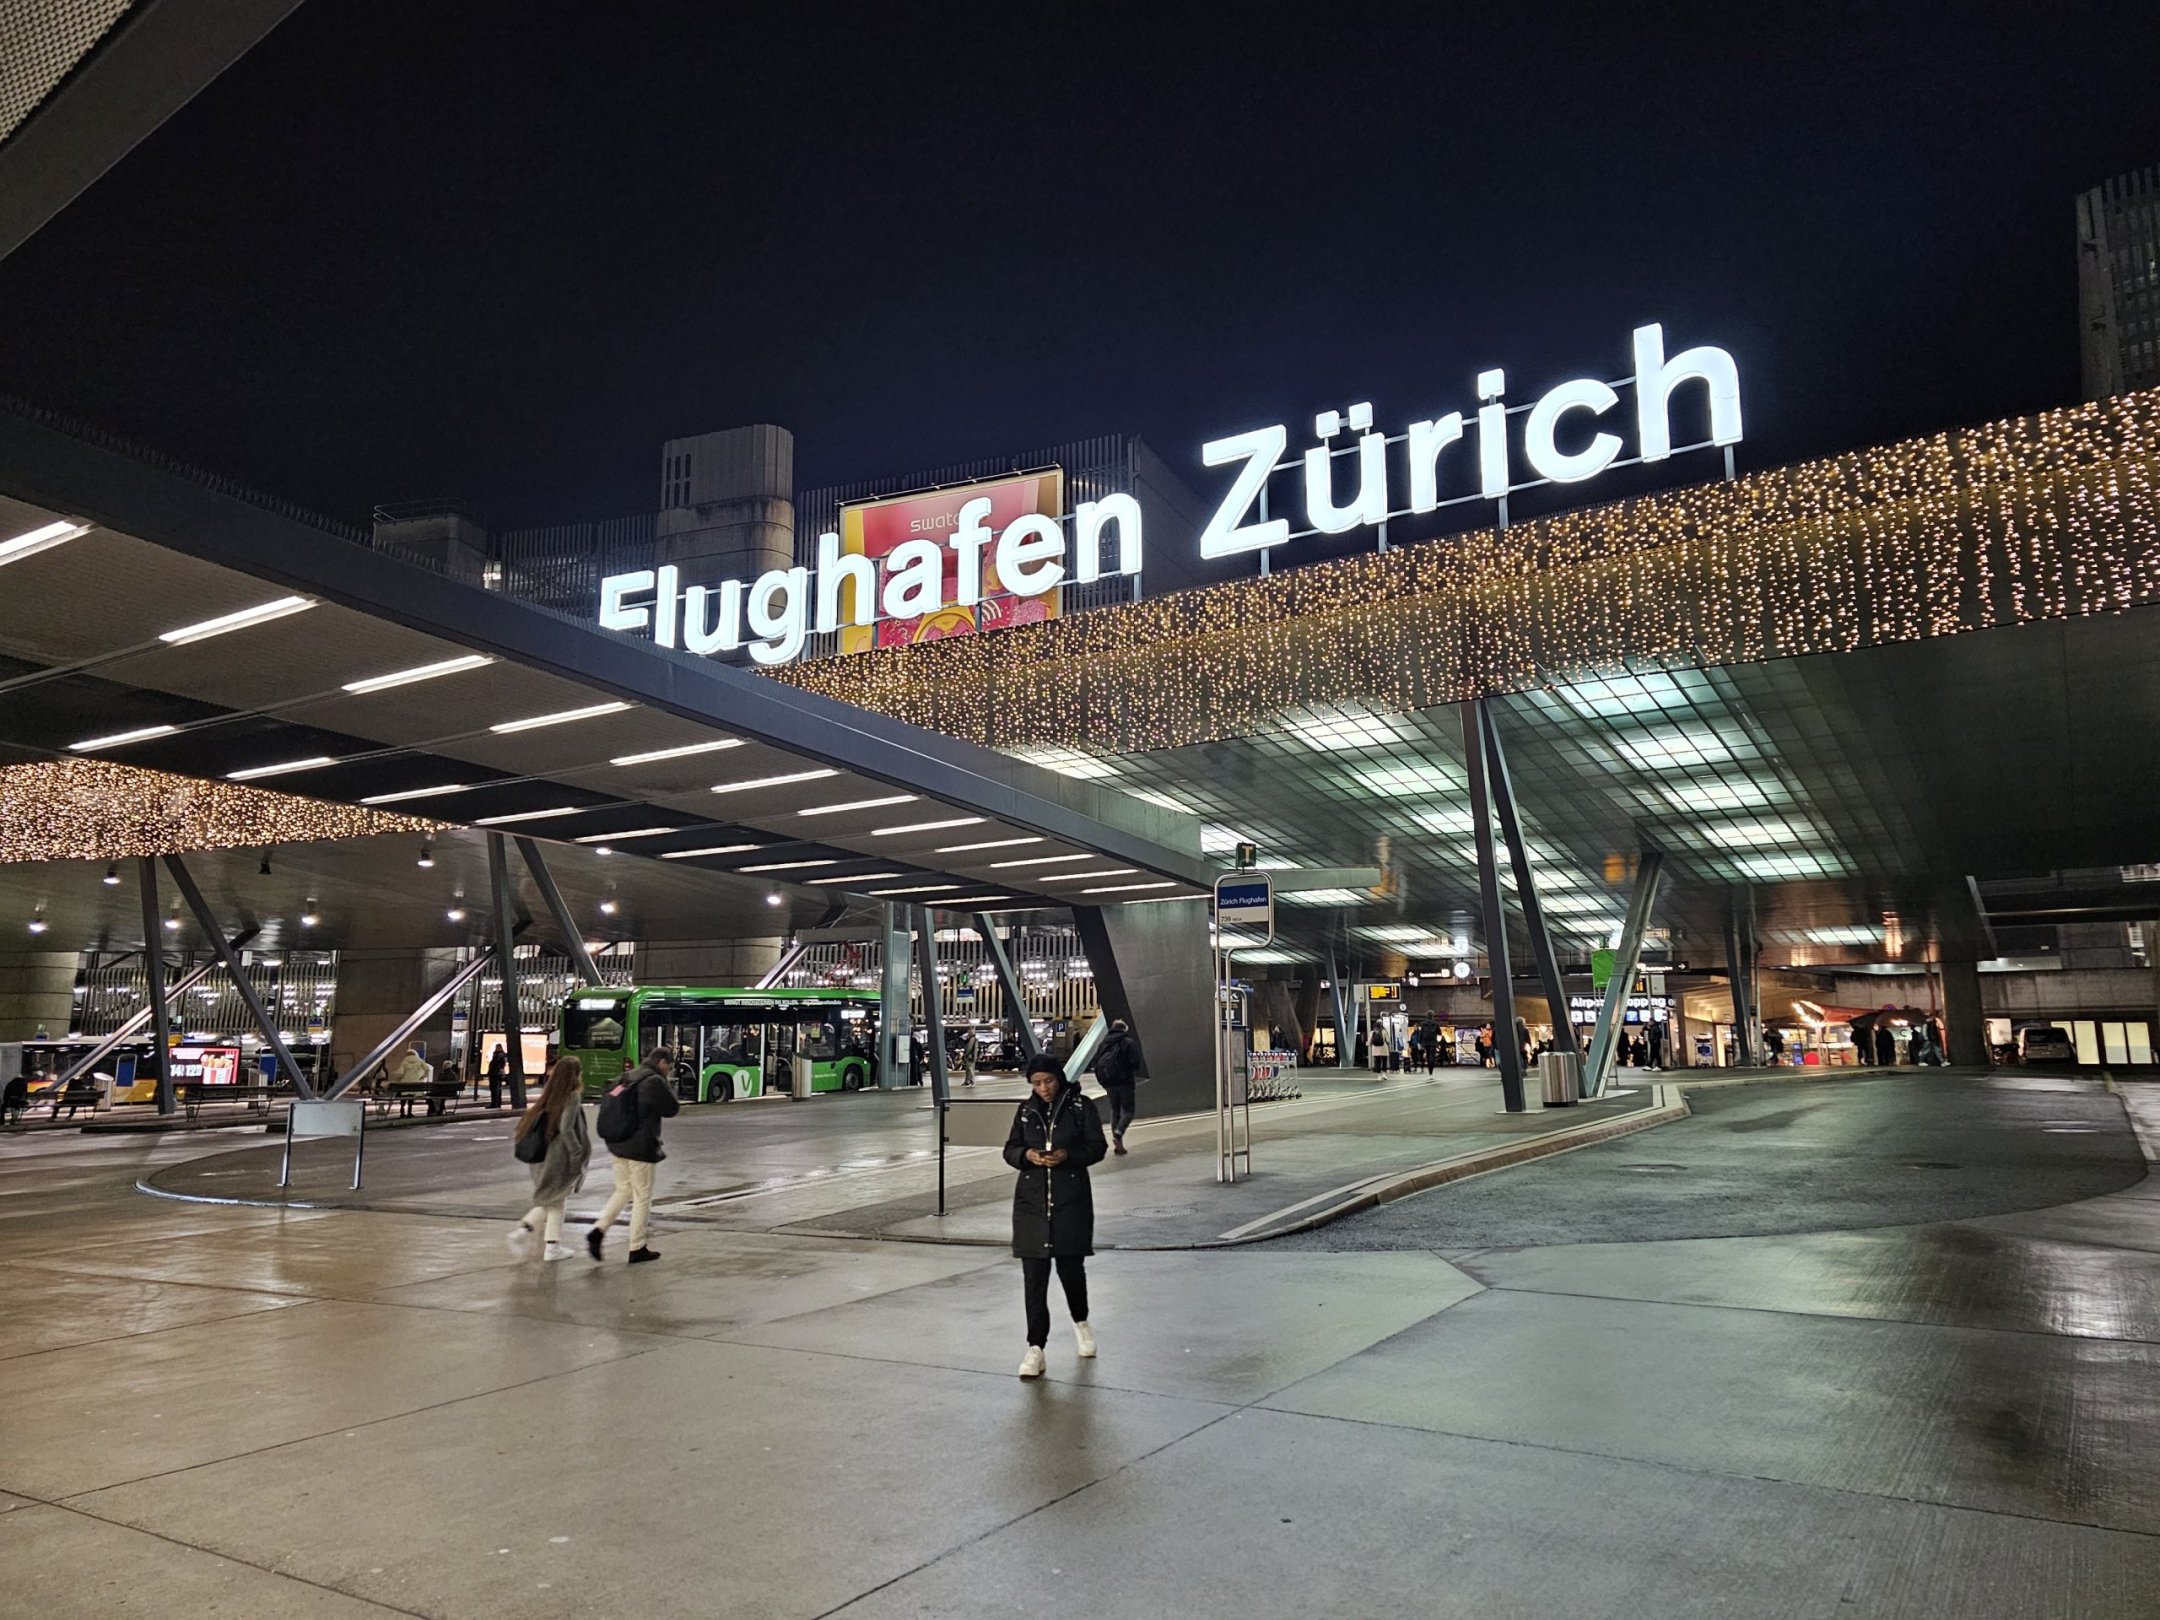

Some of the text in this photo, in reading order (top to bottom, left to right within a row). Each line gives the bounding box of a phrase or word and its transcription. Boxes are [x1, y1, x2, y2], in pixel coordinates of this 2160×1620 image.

[599, 322, 1743, 665] Flughafen Zürich
[910, 512, 960, 532] swatc
[1220, 896, 1267, 906] Zürich Flughafen
[1571, 998, 1666, 1008] Airpor oppng
